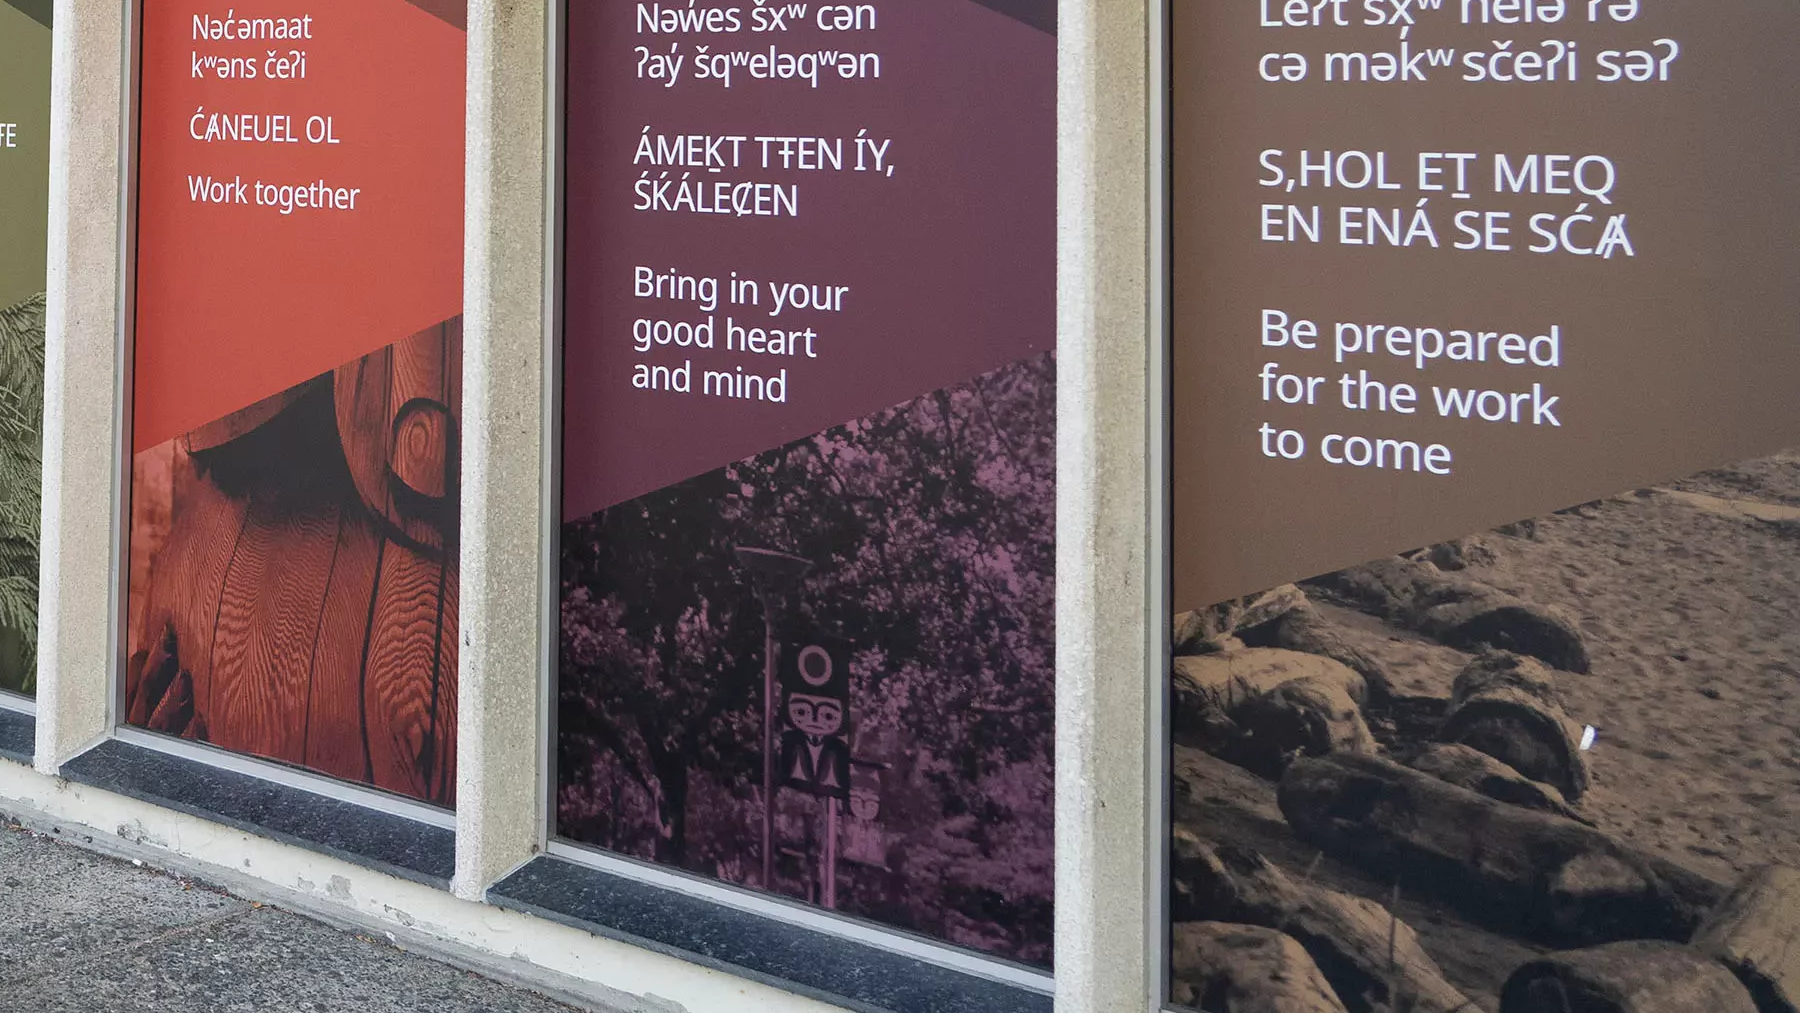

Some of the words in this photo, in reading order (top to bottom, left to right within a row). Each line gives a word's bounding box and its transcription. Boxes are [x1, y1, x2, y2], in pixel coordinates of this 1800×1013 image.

[305, 115, 340, 144] OL
[187, 175, 248, 204] Work
[254, 179, 361, 215] together
[1259, 148, 1401, 193] S,HOL
[1494, 153, 1615, 205] MEQ
[1261, 203, 1319, 243] EN
[1339, 197, 1439, 248] ENÁ
[1453, 210, 1511, 251] SE
[634, 266, 718, 312] Bring
[730, 271, 758, 305] in
[768, 281, 849, 317] your
[632, 315, 714, 352] good
[726, 316, 817, 358] heart
[1261, 308, 1318, 349] Be
[1335, 322, 1559, 369] prepared
[632, 359, 691, 393] and
[703, 365, 786, 403] mind
[1257, 362, 1326, 405] for
[1337, 369, 1417, 414] the
[1431, 382, 1561, 427] work
[1258, 422, 1305, 459] to
[1320, 434, 1451, 475] come
